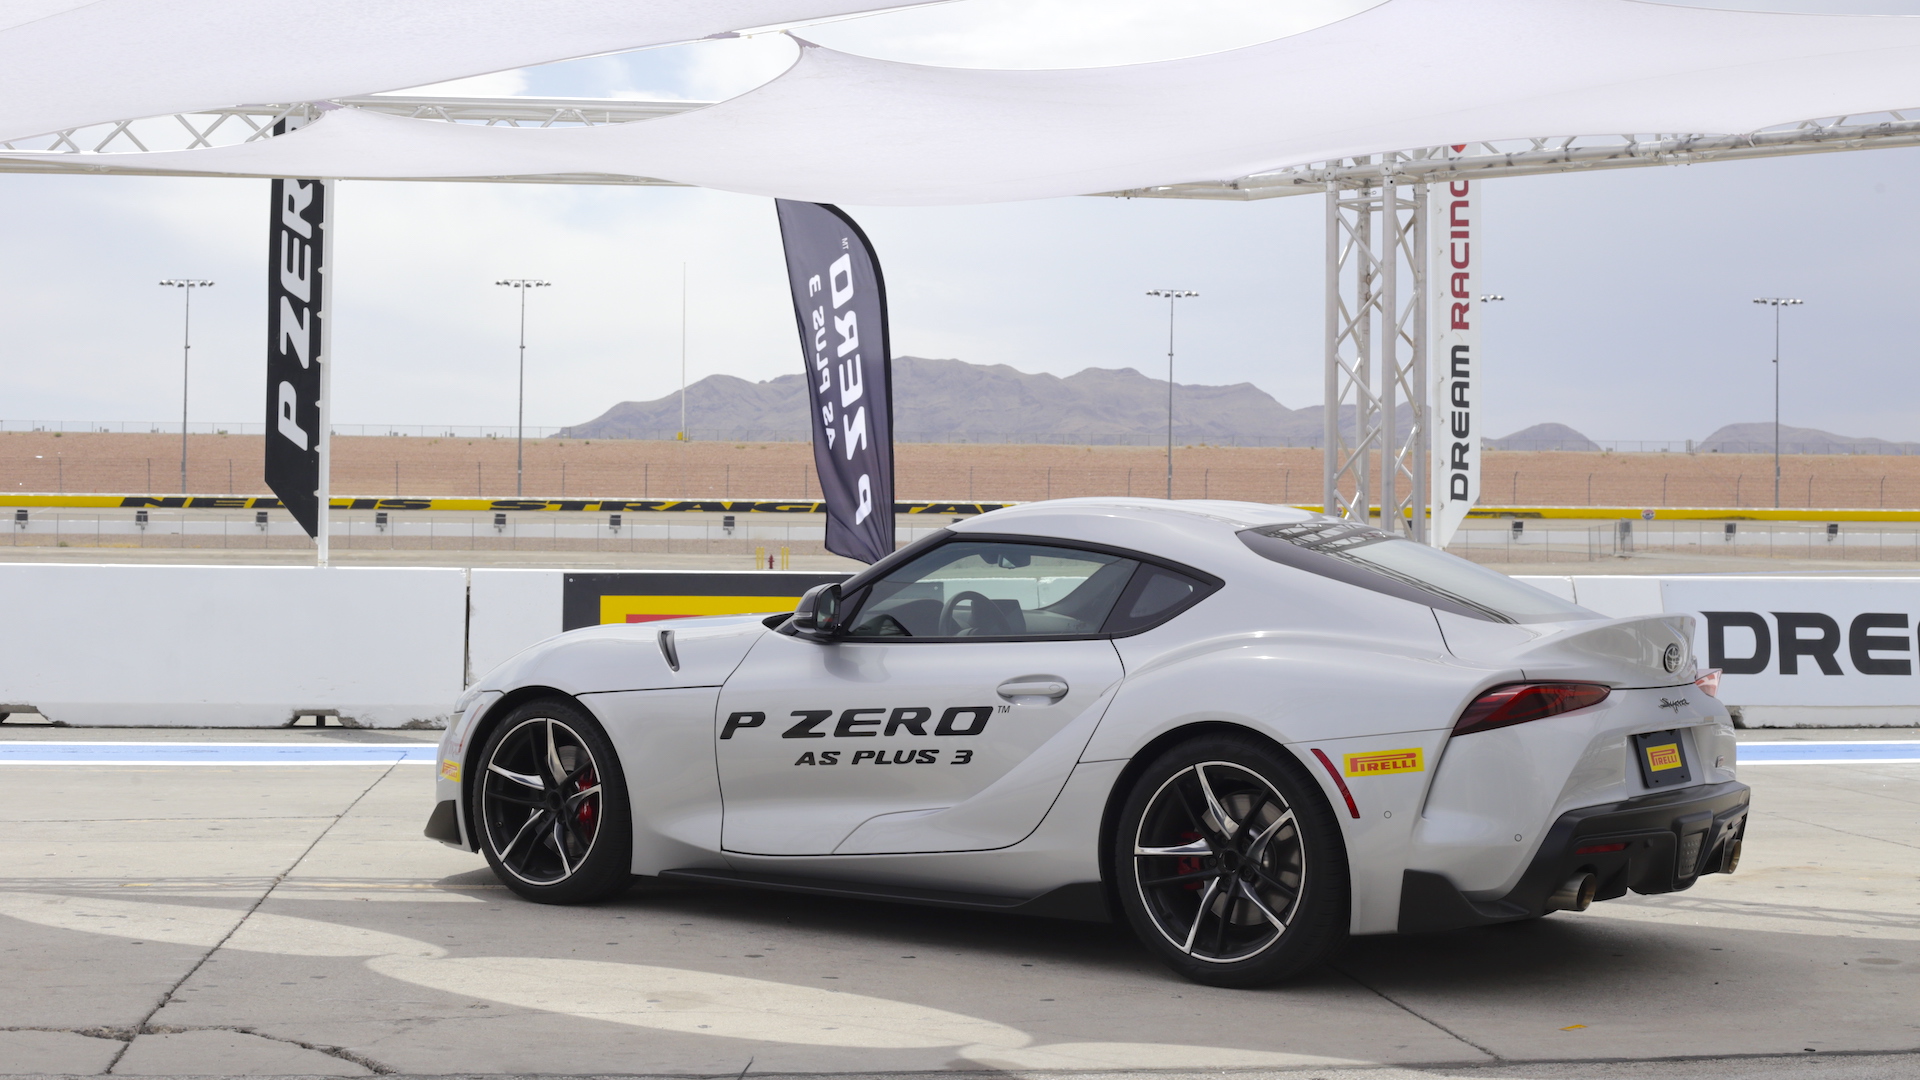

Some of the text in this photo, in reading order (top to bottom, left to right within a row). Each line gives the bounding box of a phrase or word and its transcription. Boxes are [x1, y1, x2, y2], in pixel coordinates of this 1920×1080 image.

[278, 178, 313, 451] P ZER
[1450, 344, 1470, 502] DREAM
[120, 496, 432, 511] NELIS
[1698, 611, 1920, 676] DRE
[719, 711, 766, 740] P
[781, 706, 994, 739] ZERO
[794, 749, 974, 766] AS PLUS 3
[1350, 752, 1417, 773] PIRELLI
[1649, 748, 1678, 766] PIRELLI
